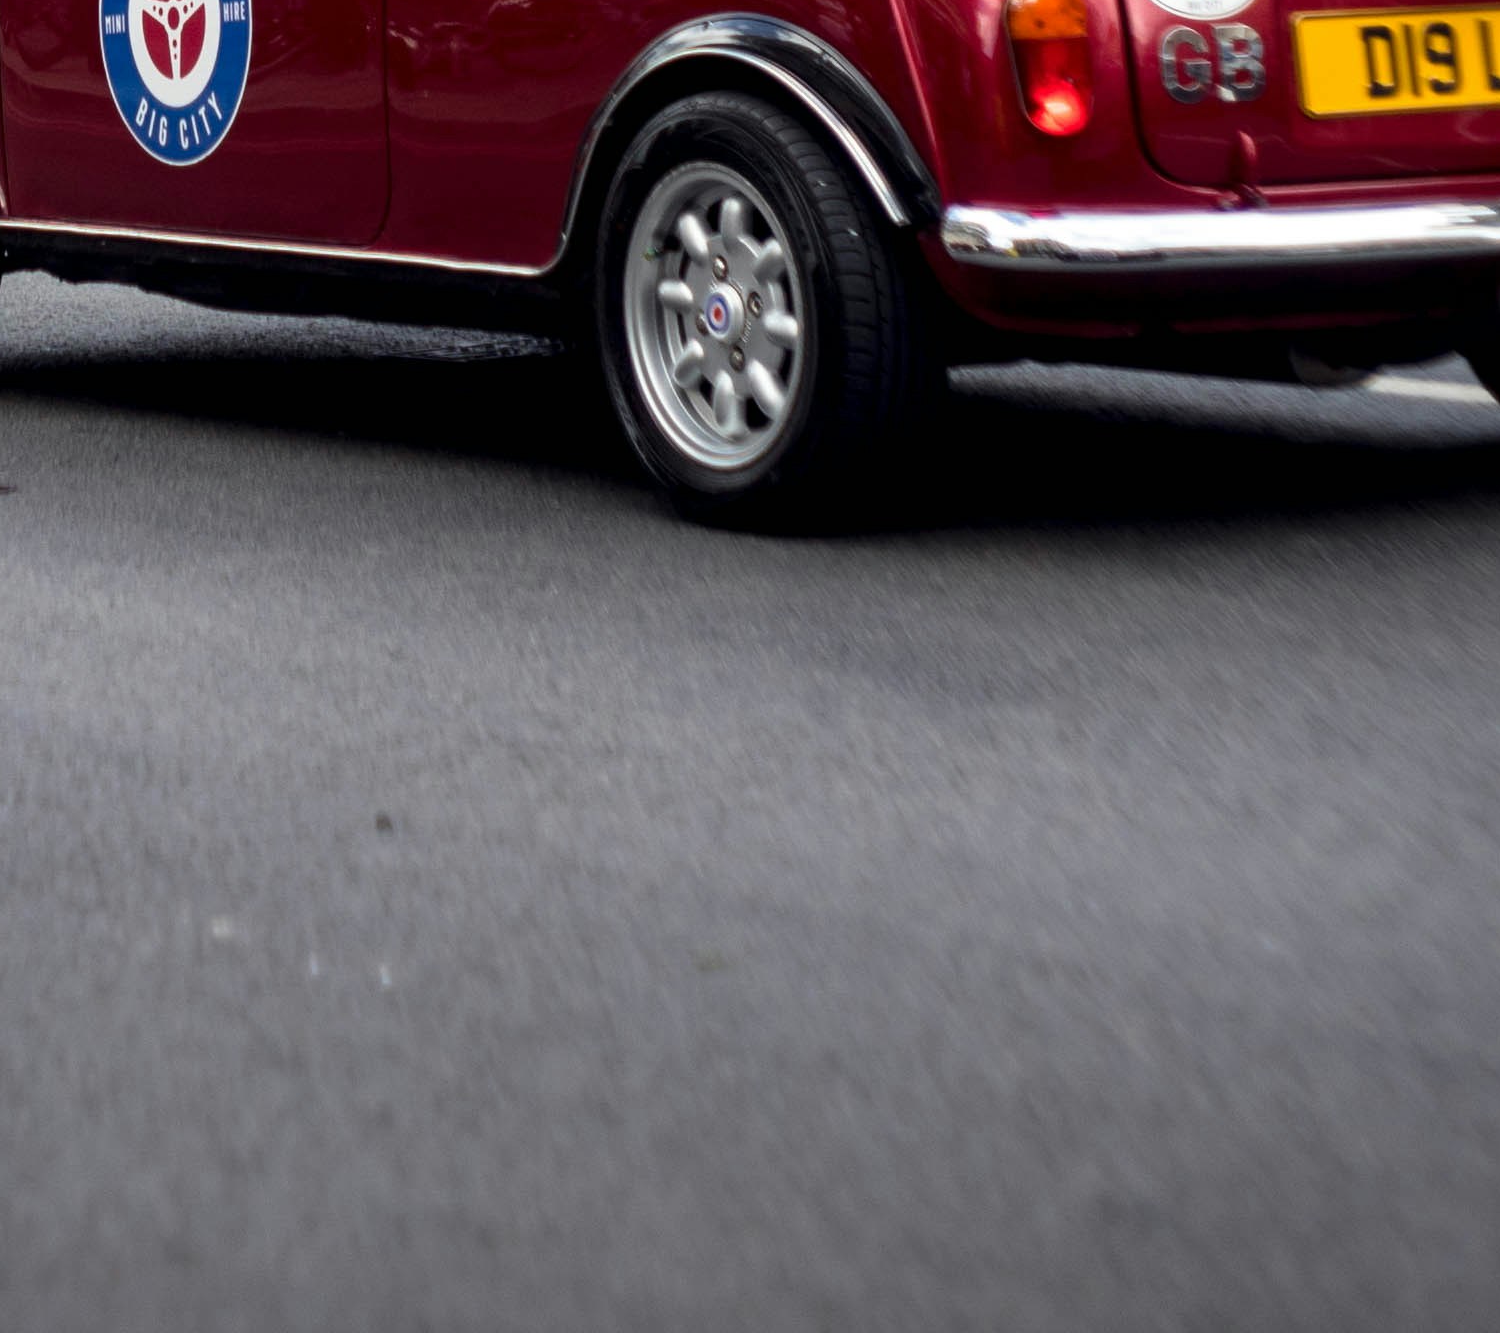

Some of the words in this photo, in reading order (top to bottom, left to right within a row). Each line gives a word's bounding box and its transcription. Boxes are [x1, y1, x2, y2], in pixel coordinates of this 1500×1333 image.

[104, 13, 126, 35] MINI
[222, 0, 246, 23] HIRE
[1160, 23, 1265, 104] GB
[1358, 22, 1461, 99] D19
[135, 96, 168, 148] BIG
[178, 91, 223, 151] CITY
